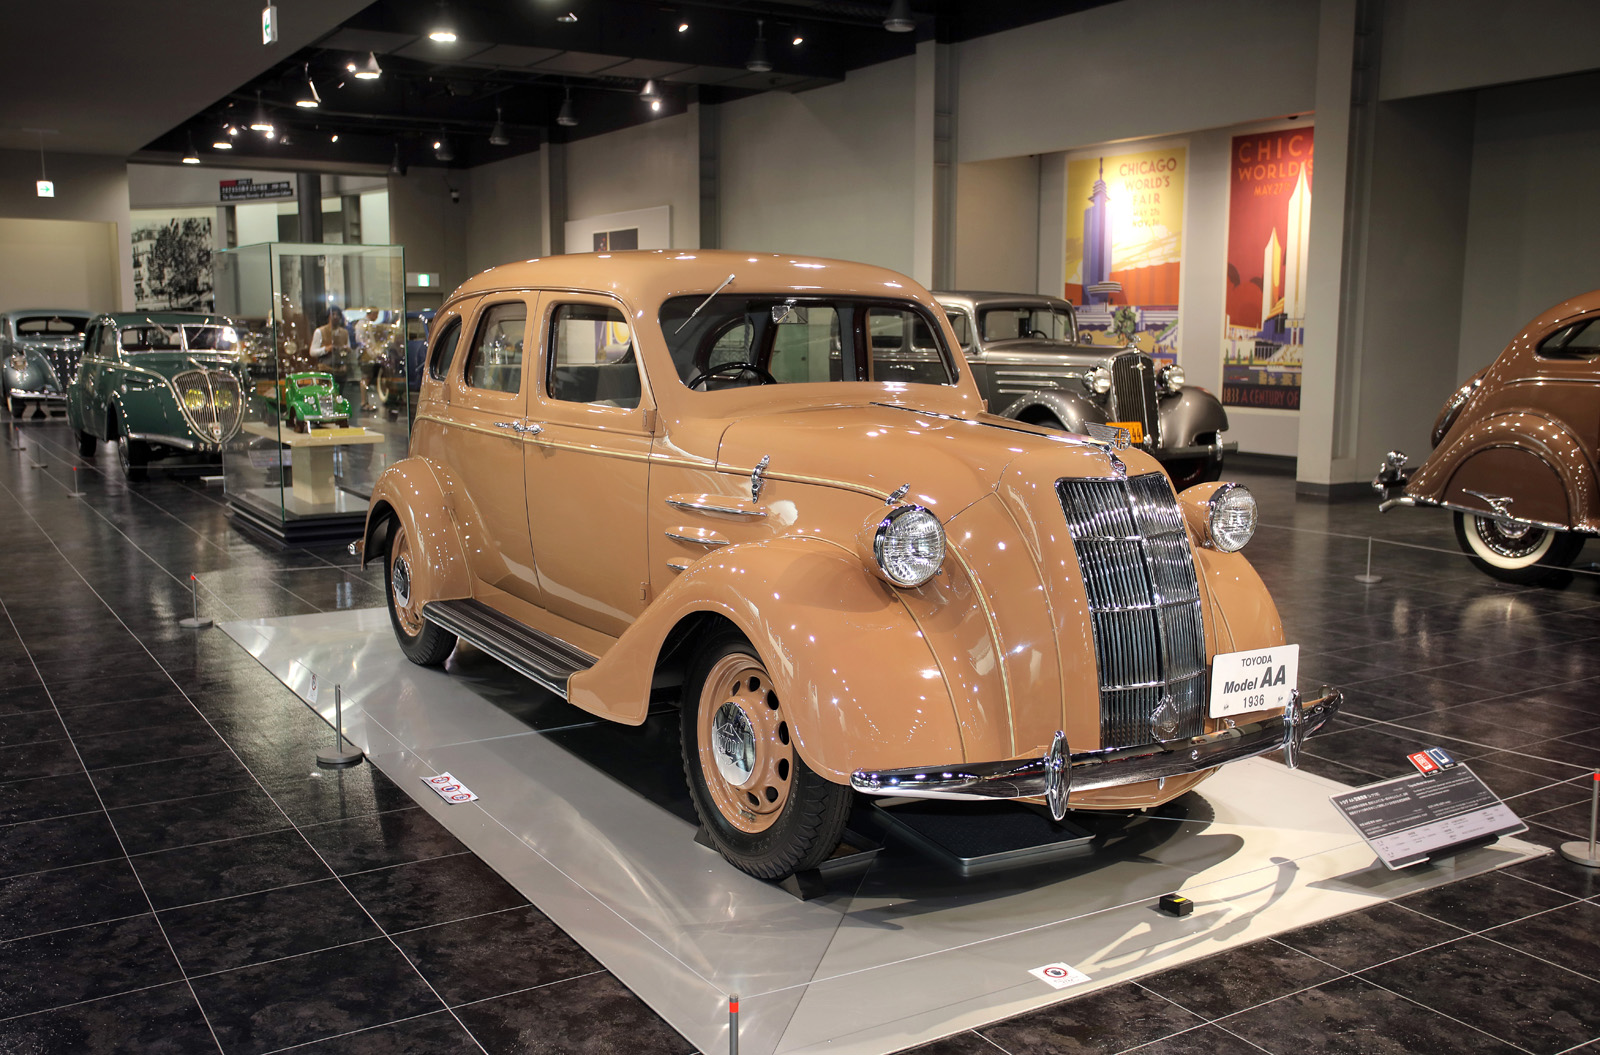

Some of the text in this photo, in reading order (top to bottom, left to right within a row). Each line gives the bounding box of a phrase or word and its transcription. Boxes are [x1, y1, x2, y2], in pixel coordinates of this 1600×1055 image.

[1239, 135, 1313, 163] CHIC
[1119, 157, 1177, 176] CHICAGO
[1124, 175, 1170, 191] WORLD'S
[1253, 184, 1273, 197] MAY
[1132, 193, 1161, 206] FAIR
[1223, 387, 1299, 406] 1833 A CENTURY OF
[1241, 655, 1273, 667] TOYODA
[1223, 664, 1286, 694] Model AA
[1243, 694, 1265, 708] 1936
